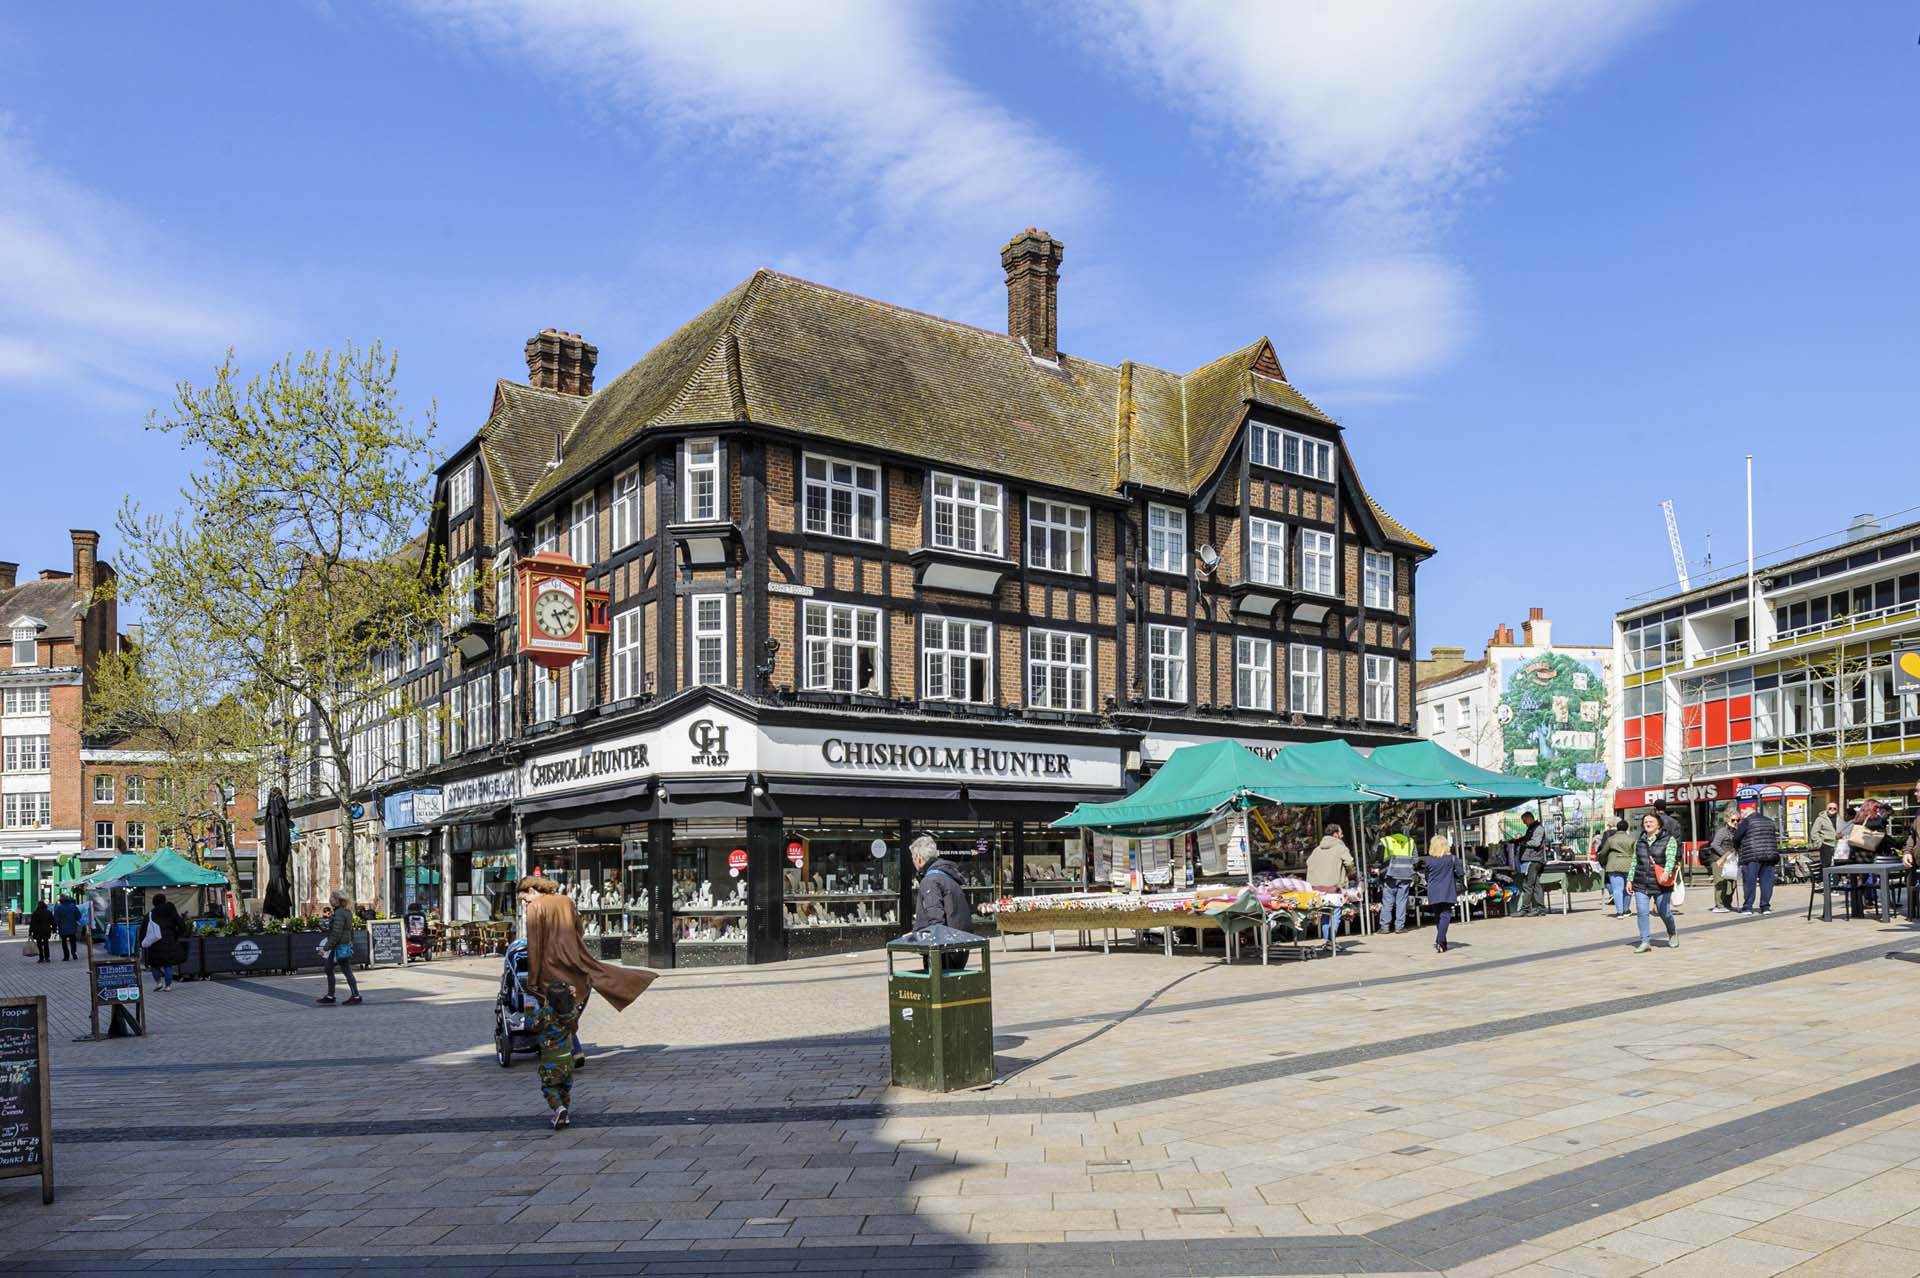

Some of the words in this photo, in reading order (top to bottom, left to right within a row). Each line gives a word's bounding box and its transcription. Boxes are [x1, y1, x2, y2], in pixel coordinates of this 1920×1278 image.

[529, 753, 592, 787] CHISHOLM
[591, 743, 650, 777] HUNTER
[706, 755, 729, 766] 1857
[822, 738, 966, 771] CHISHOLM
[970, 746, 1072, 776] HUNTER
[448, 779, 500, 802] STONEHENGE
[898, 990, 922, 1000] Litter
